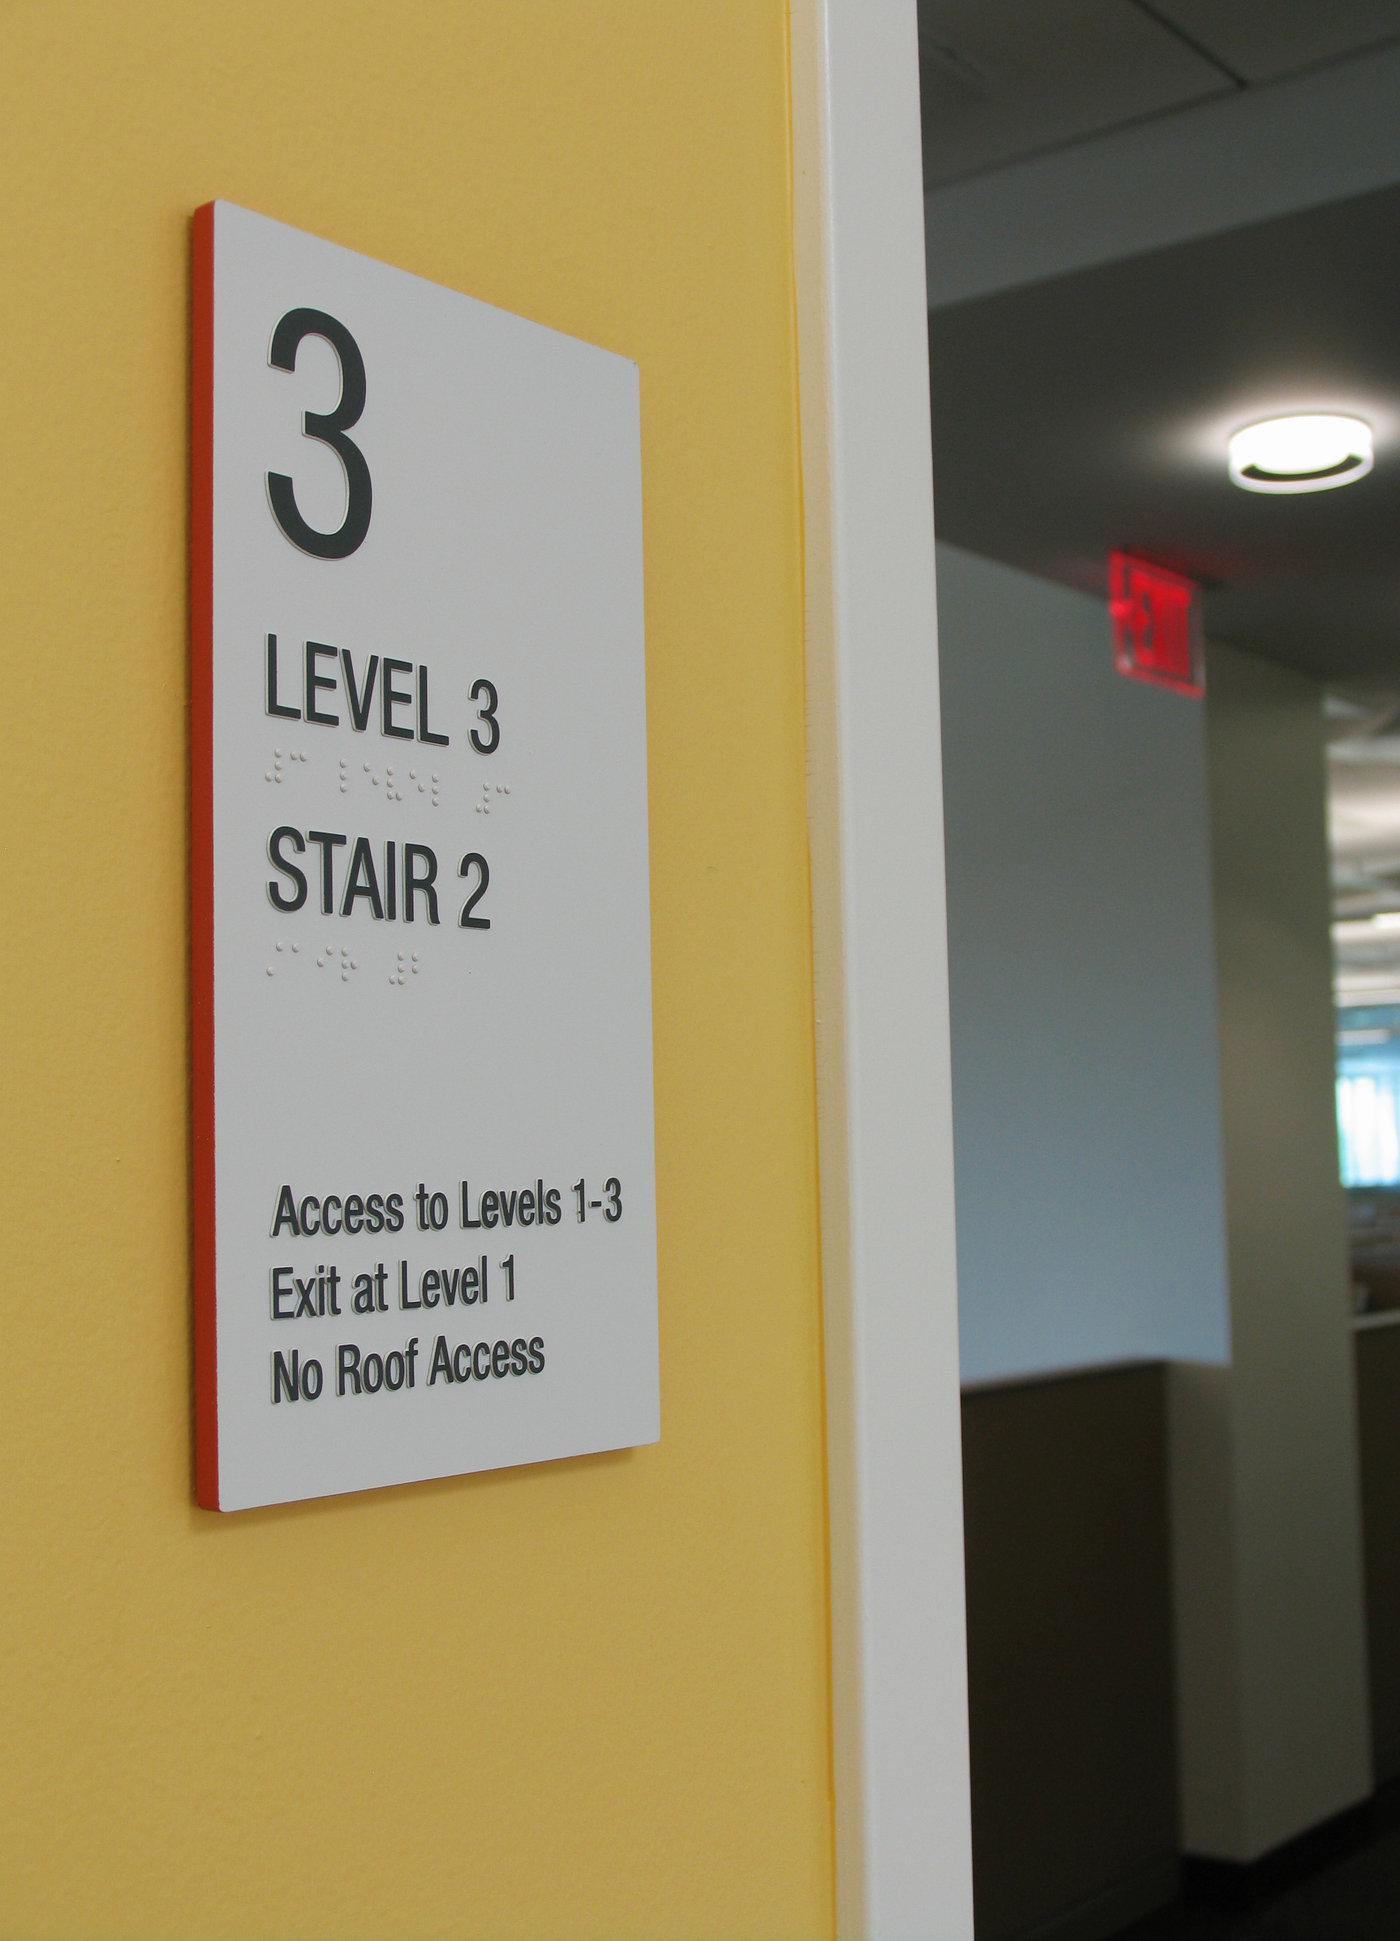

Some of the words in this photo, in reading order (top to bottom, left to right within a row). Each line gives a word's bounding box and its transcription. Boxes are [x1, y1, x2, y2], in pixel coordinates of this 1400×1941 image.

[266, 307, 373, 560] 3
[266, 633, 450, 746] LEVEL
[469, 678, 501, 755] 3
[267, 825, 441, 925] STAIR
[457, 852, 491, 930] 2
[272, 1184, 405, 1237] Access
[413, 1183, 449, 1231] to
[461, 1178, 562, 1230] Levels
[572, 1176, 623, 1223] 1-3
[272, 1265, 342, 1320] Exit
[353, 1263, 389, 1314] at
[399, 1255, 488, 1311] Level
[500, 1253, 516, 1303] 1
[273, 1349, 324, 1404] No
[335, 1337, 419, 1397] Roof
[426, 1335, 546, 1387] Access
